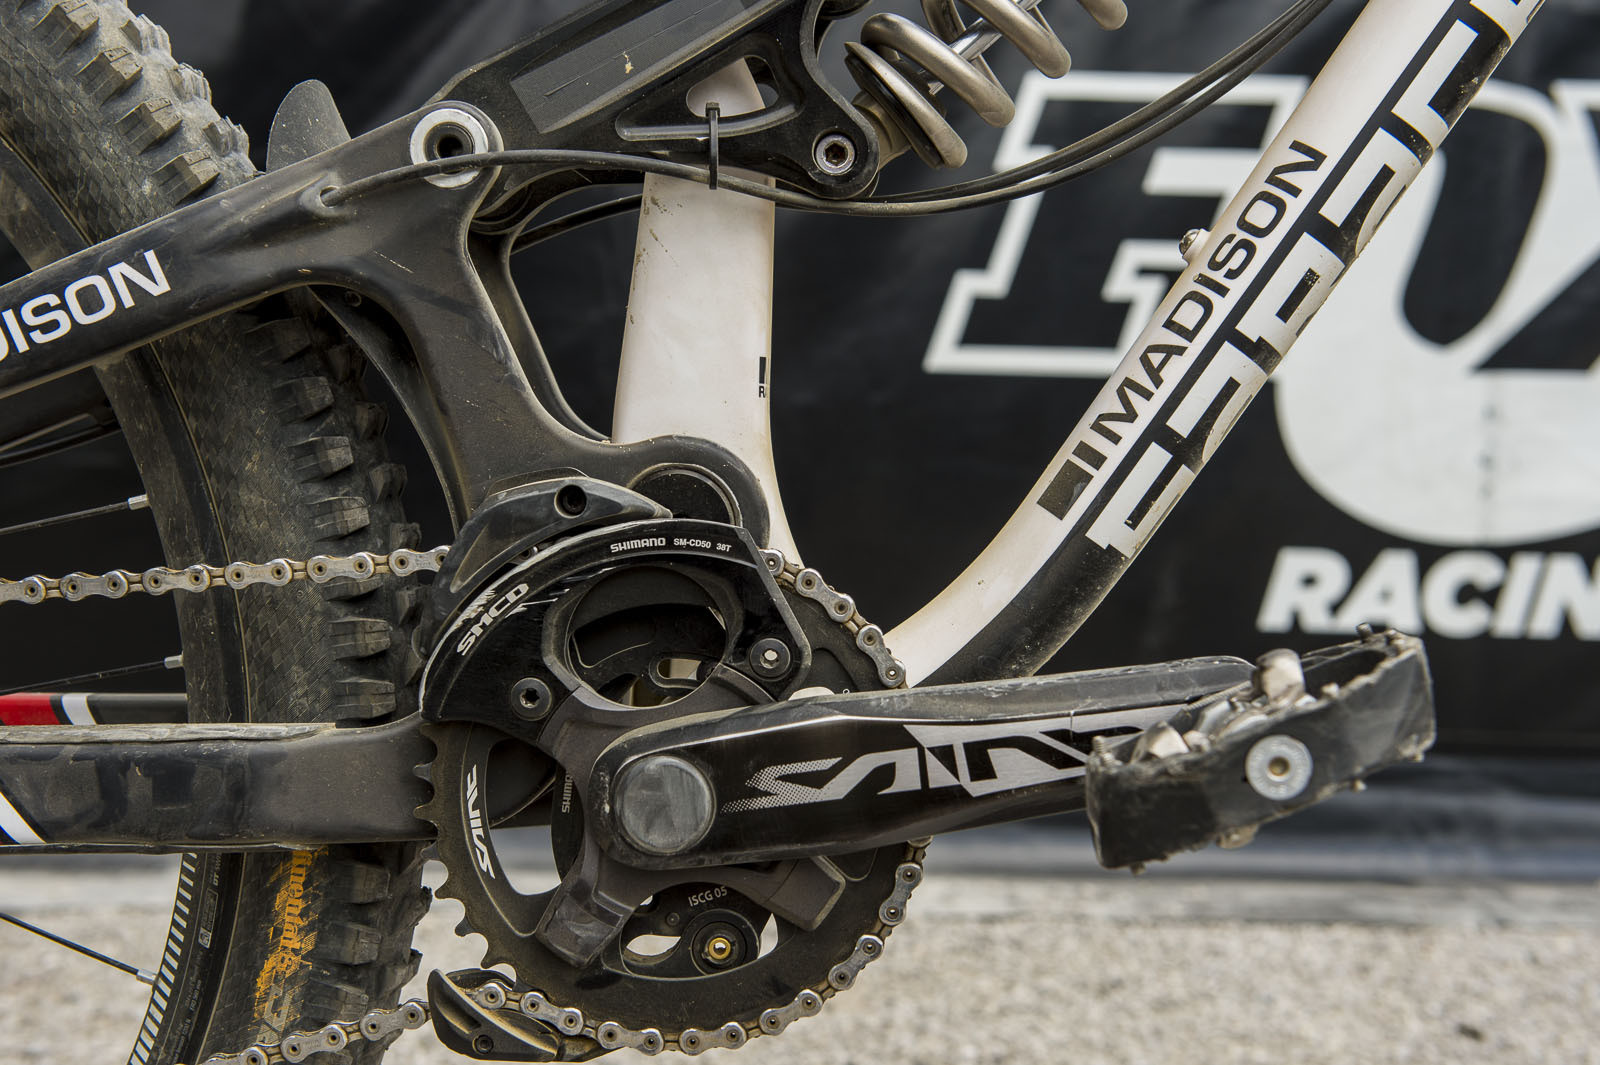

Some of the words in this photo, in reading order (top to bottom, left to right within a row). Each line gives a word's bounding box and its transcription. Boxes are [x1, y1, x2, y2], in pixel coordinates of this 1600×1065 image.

[0, 249, 171, 363] ISON
[610, 537, 666, 553] SHIMANO
[673, 538, 712, 549] SM-CD50
[716, 542, 732, 552] 38T
[466, 764, 496, 879] SAINT
[688, 890, 713, 907] ISCG
[714, 885, 728, 898] 05
